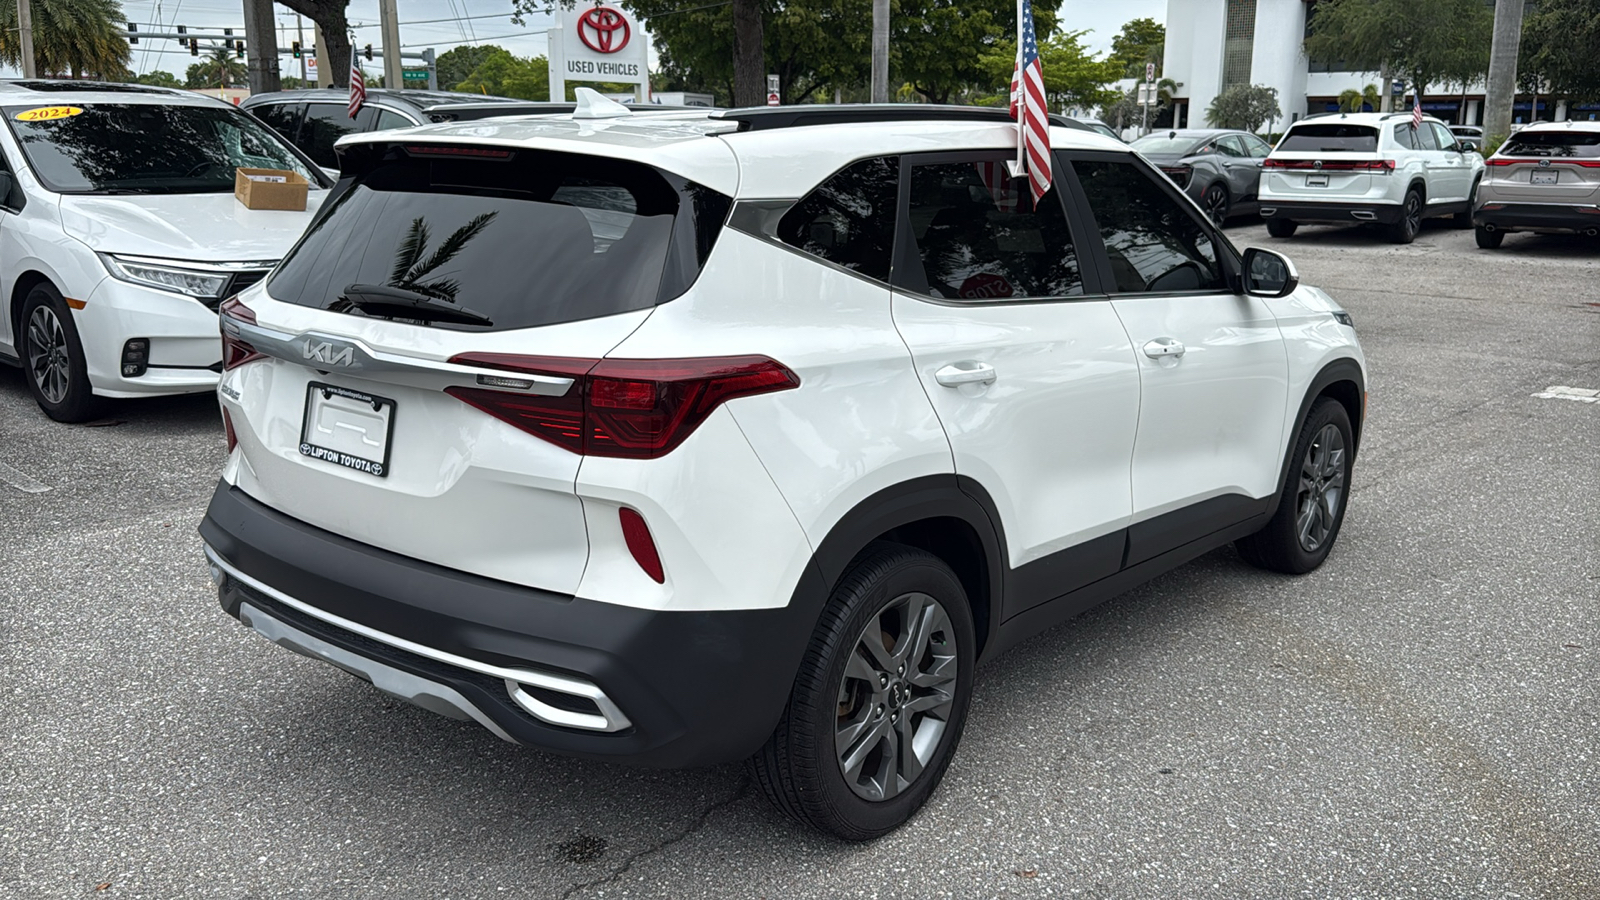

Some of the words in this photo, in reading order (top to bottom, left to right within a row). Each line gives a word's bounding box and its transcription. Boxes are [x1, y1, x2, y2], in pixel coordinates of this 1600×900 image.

[567, 60, 595, 74] USED
[596, 61, 639, 76] VEHICLES
[28, 107, 72, 121] 2024
[303, 338, 354, 367] KIA
[310, 446, 339, 463] LIPTON
[340, 454, 372, 473] TOYOTA
